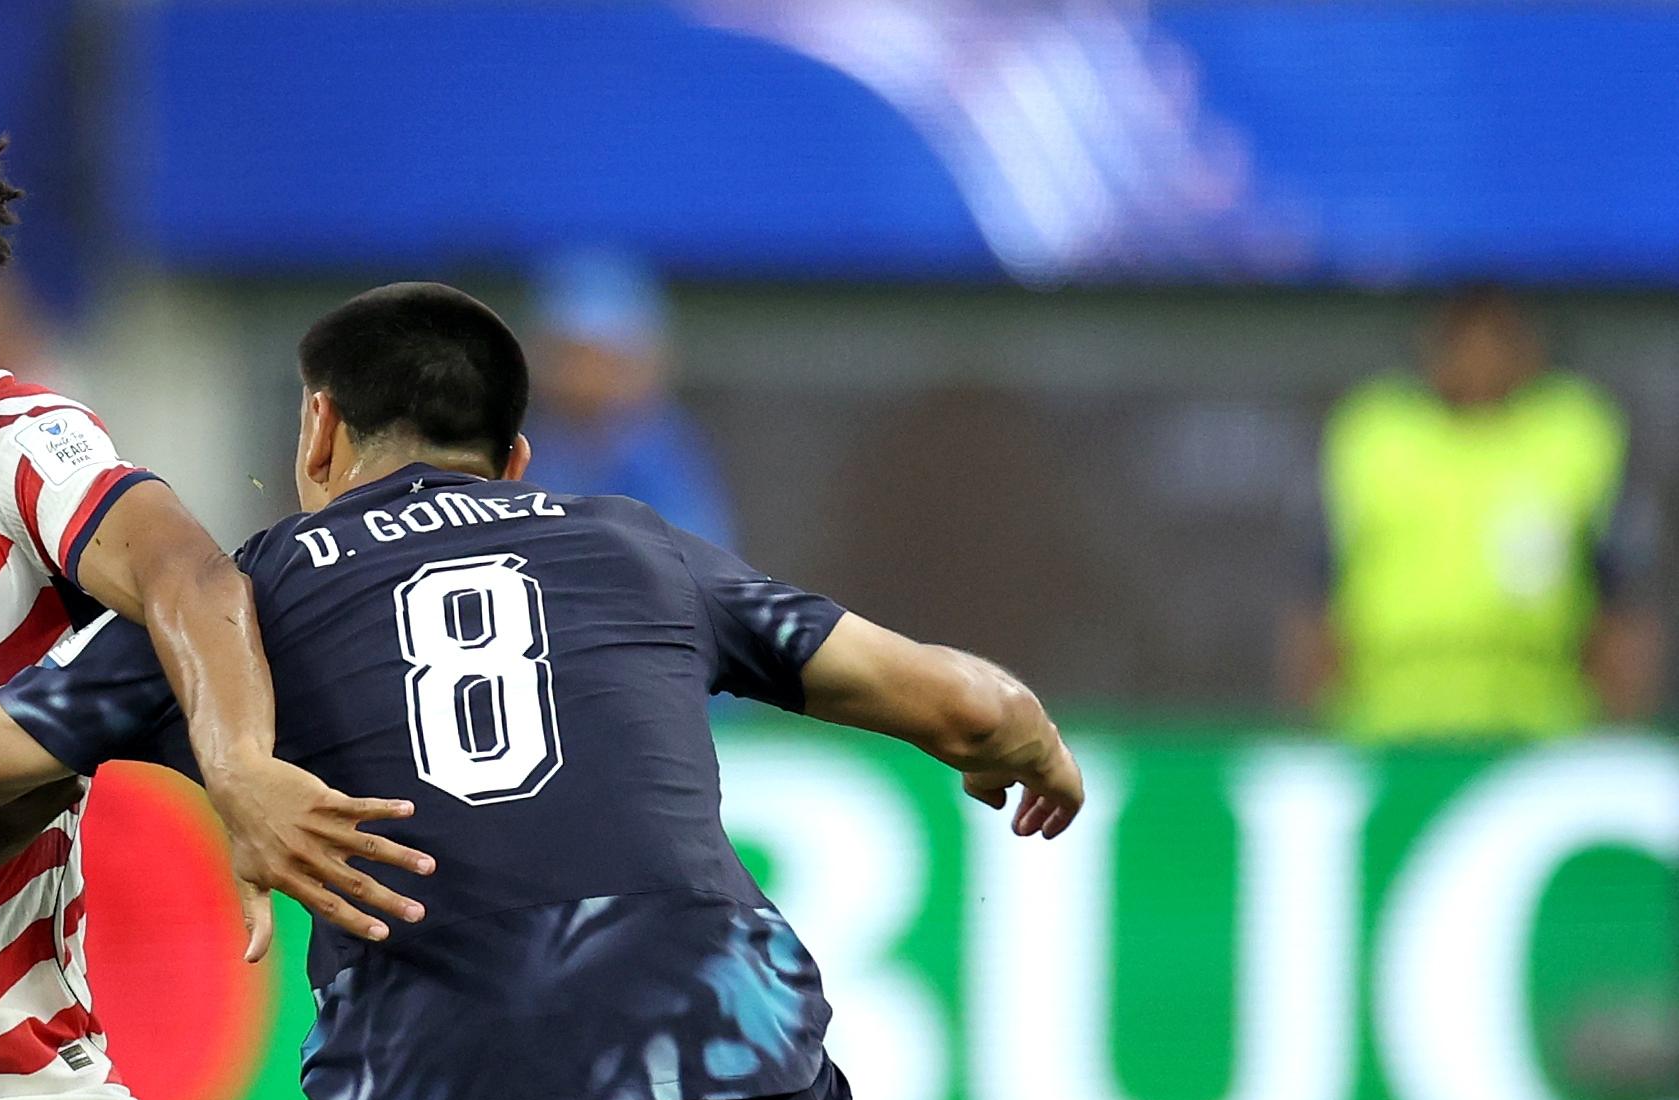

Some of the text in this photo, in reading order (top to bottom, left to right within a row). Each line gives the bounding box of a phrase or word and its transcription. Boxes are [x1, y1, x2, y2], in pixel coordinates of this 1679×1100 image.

[55, 440, 94, 463] PEACE
[295, 492, 566, 567] D. GOMEZ
[393, 552, 563, 806] 8
